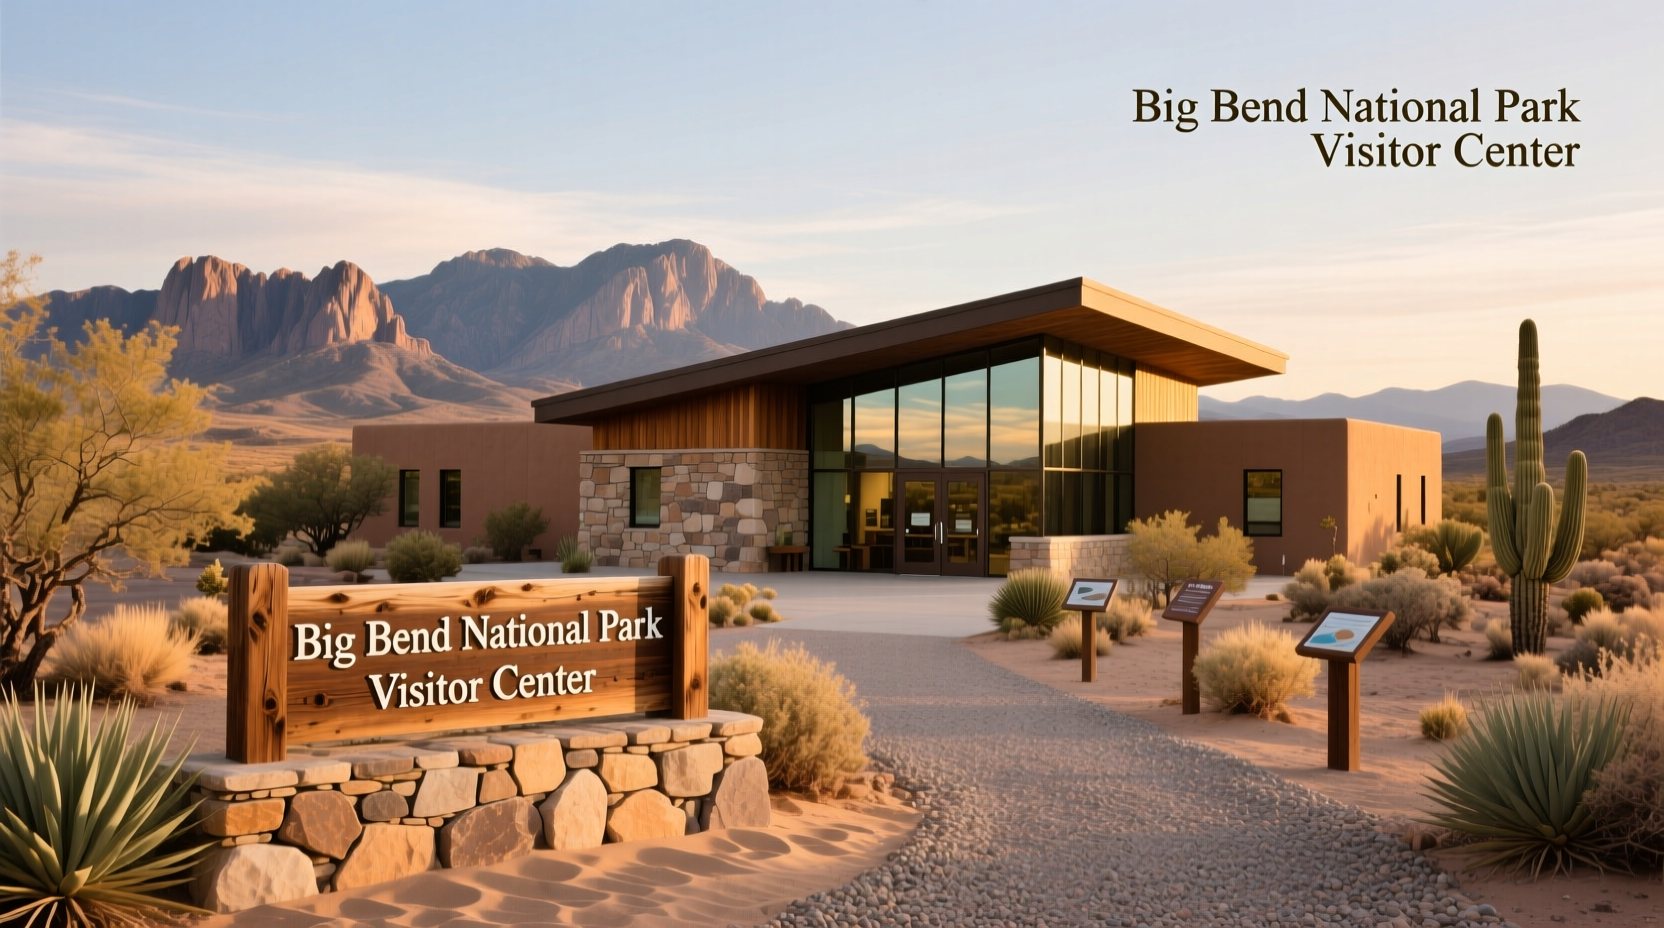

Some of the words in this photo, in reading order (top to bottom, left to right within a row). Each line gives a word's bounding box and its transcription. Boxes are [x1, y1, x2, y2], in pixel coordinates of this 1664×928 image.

[293, 623, 356, 669] Big
[365, 616, 453, 656] Bend
[461, 610, 591, 652] National
[599, 606, 664, 643] Park
[368, 670, 484, 711] Visitor
[493, 664, 598, 700] Center
